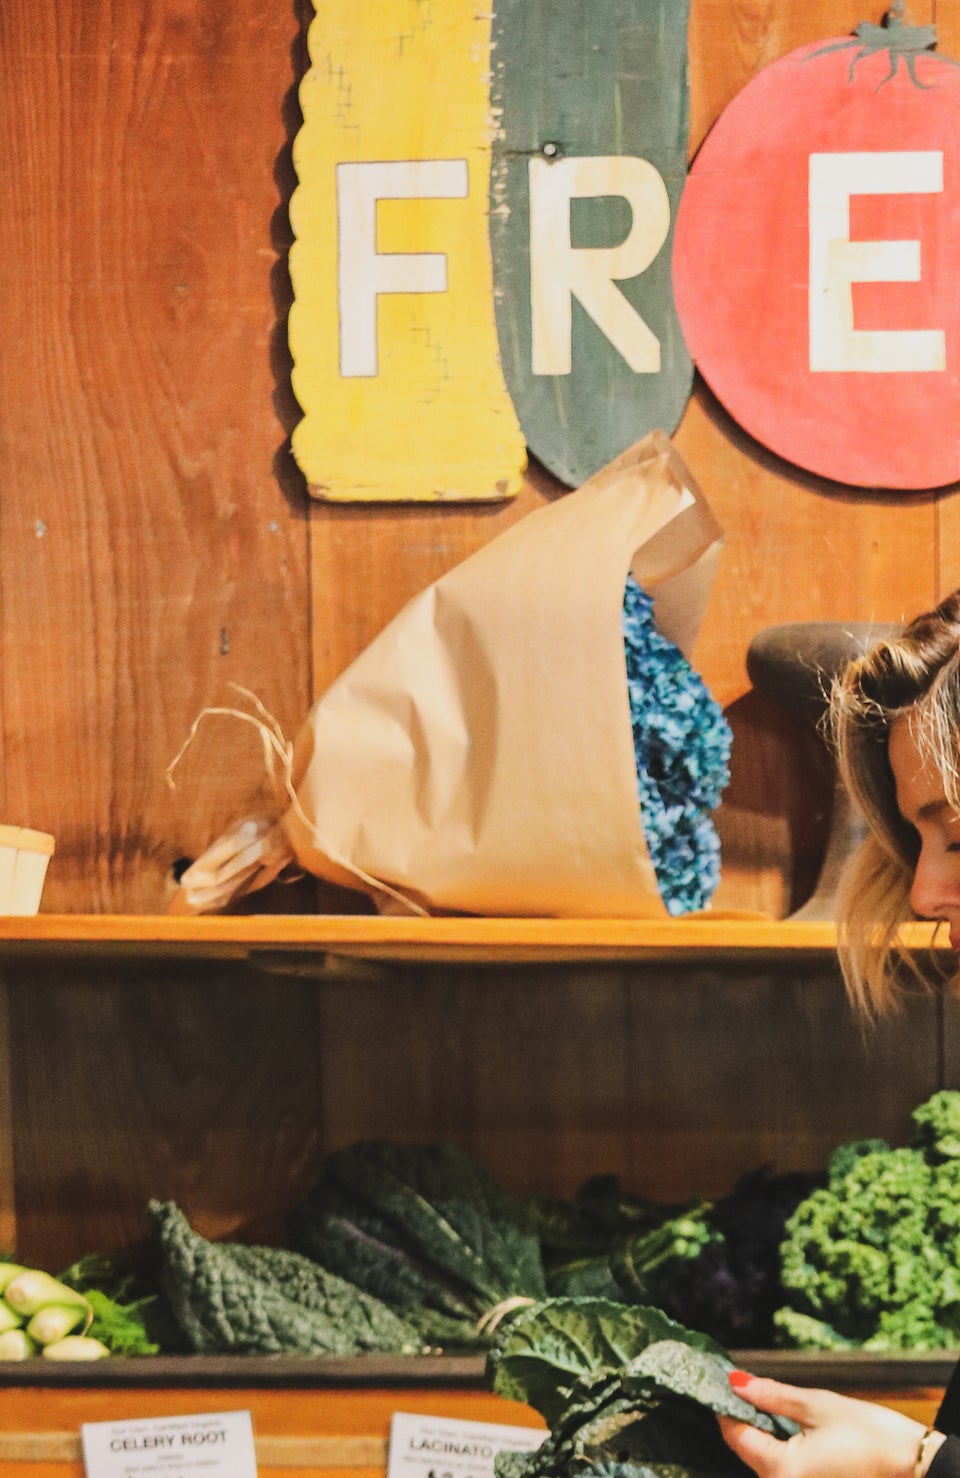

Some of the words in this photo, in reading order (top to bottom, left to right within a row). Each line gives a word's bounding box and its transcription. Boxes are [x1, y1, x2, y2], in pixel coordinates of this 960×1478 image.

[110, 1434, 174, 1452] CELERY
[181, 1429, 227, 1446] ROOT
[410, 1437, 493, 1459] LACINATO
